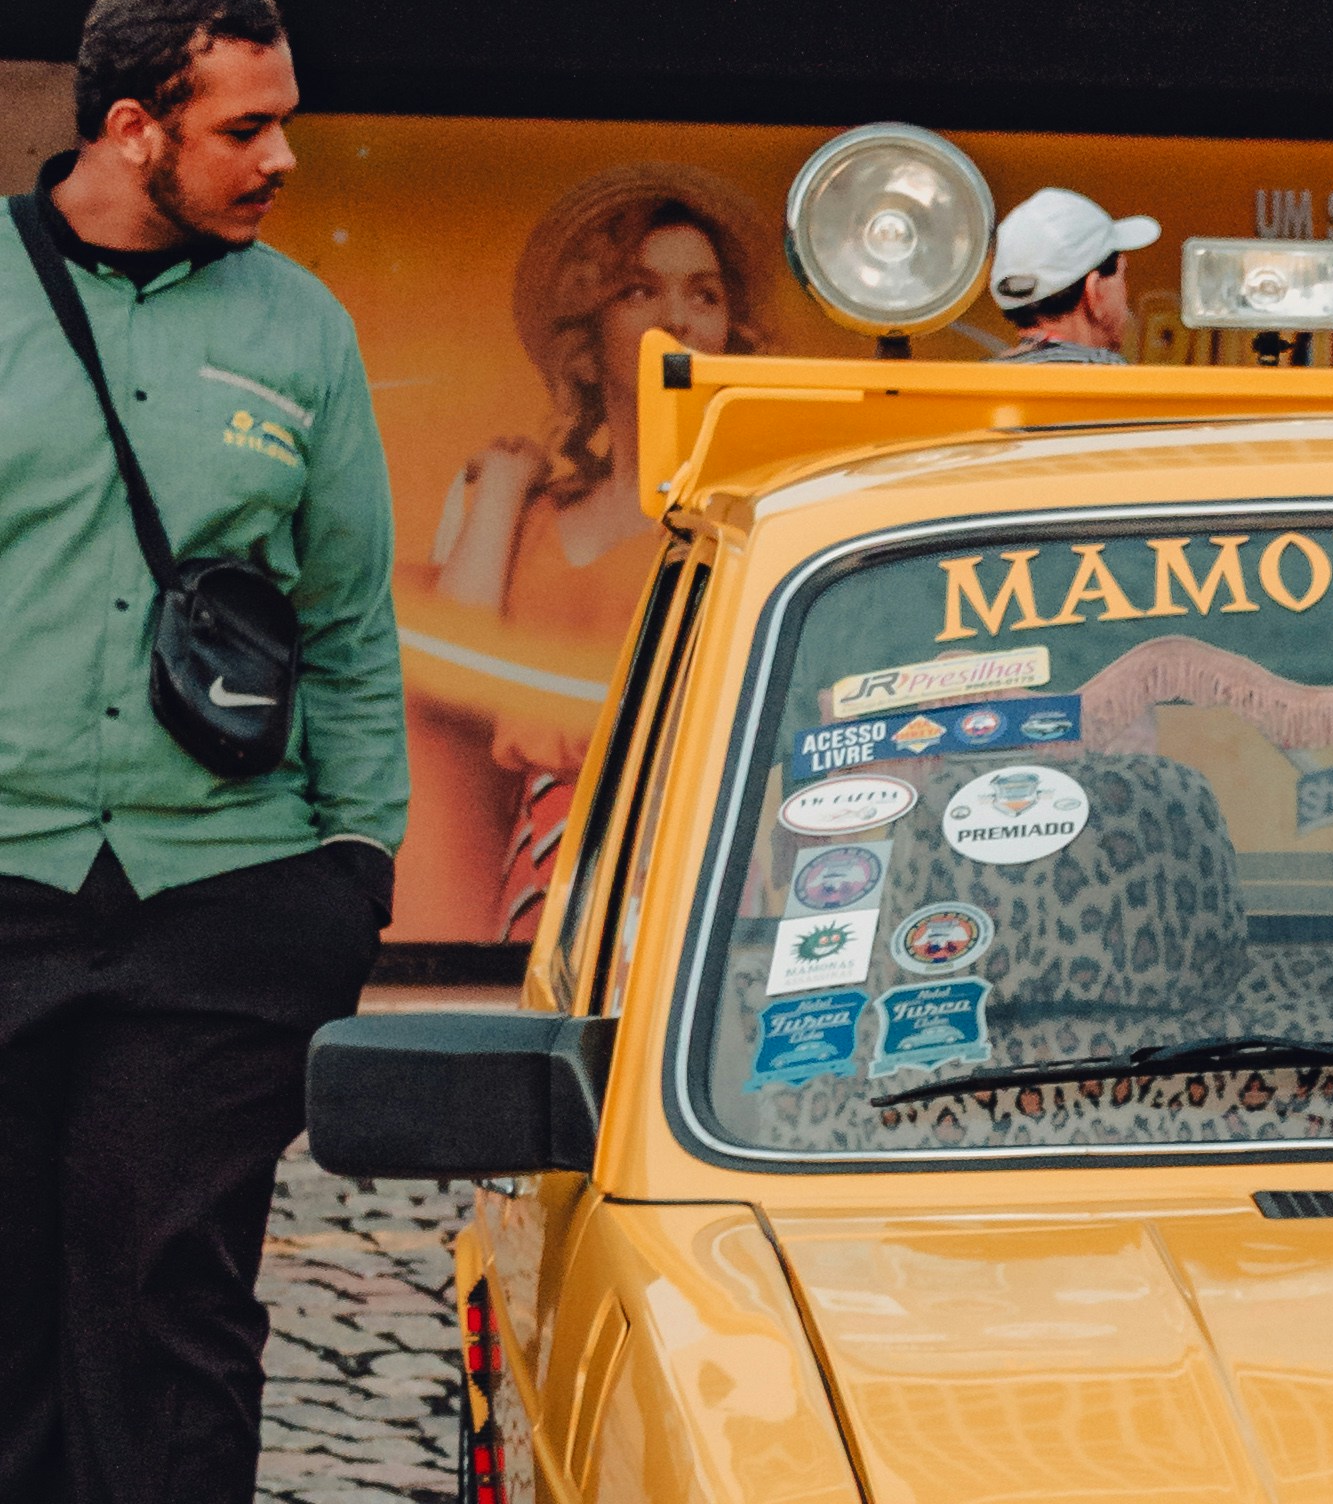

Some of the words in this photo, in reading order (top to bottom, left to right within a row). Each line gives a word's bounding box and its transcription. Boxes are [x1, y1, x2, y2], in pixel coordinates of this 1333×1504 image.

[1256, 190, 1313, 240] UM
[907, 659, 1035, 693] Presilhas
[802, 721, 886, 756] ACESSO
[811, 744, 875, 773] LIVRE
[956, 821, 1077, 844] PREMIADO
